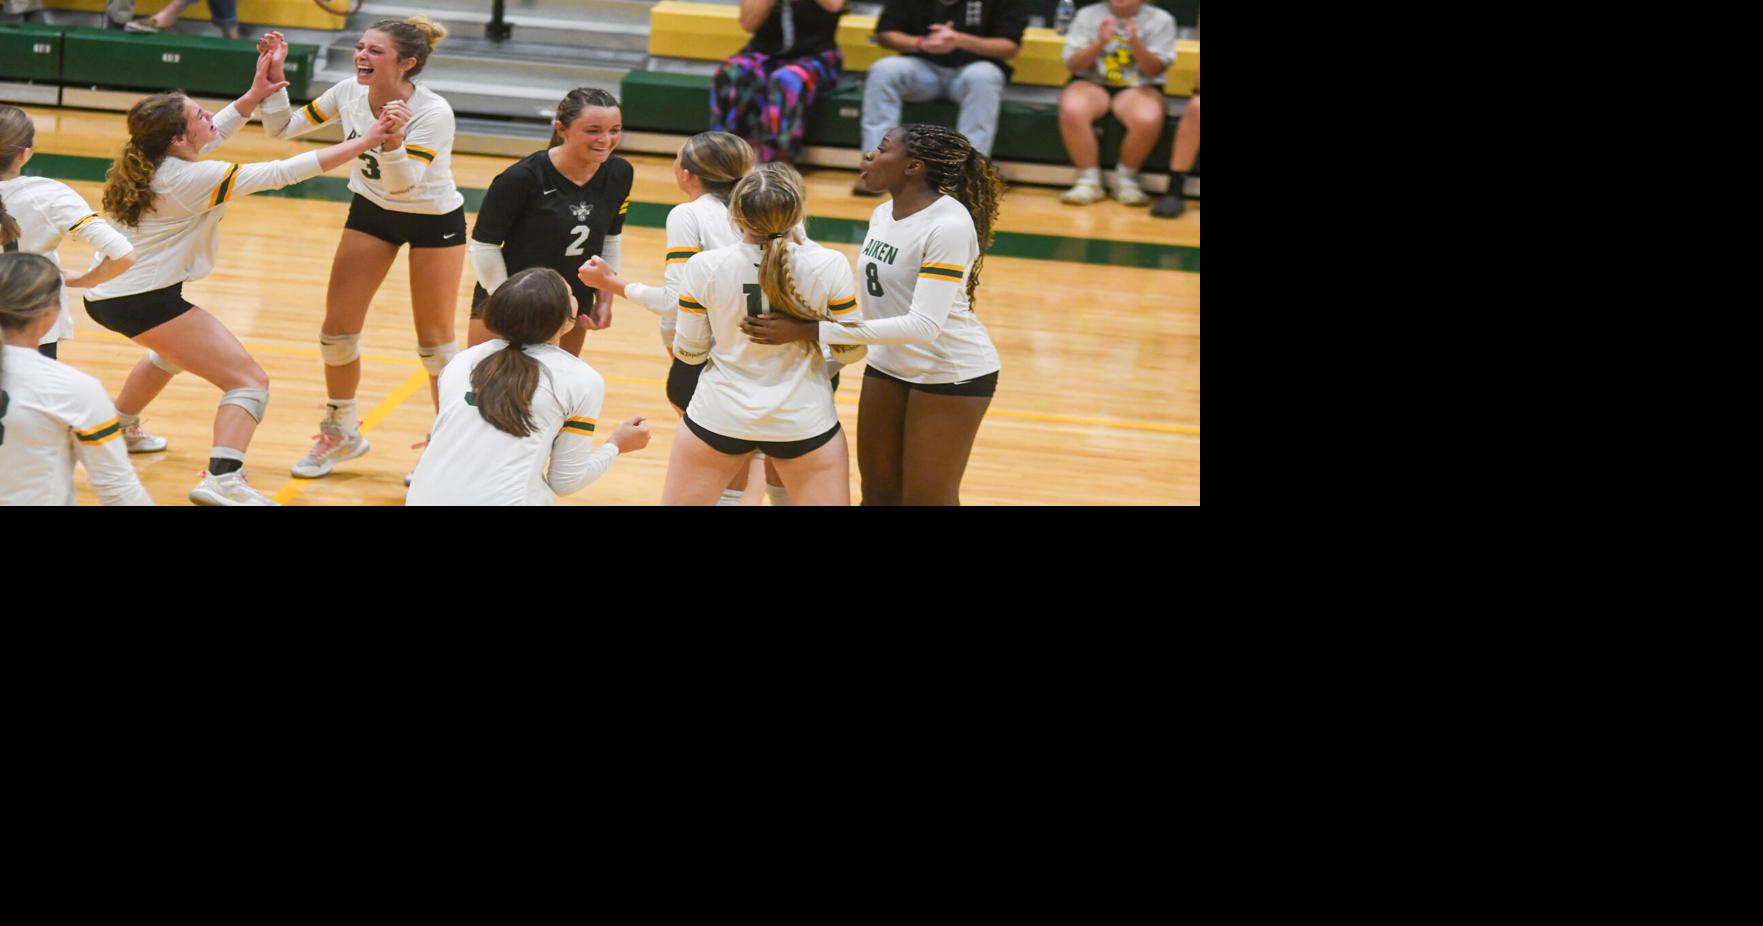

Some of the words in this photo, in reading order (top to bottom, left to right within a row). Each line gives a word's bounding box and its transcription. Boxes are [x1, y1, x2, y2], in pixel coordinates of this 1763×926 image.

[358, 153, 381, 180] 3
[565, 225, 590, 256] 2
[863, 239, 898, 265] AIKEN
[866, 262, 884, 297] 8
